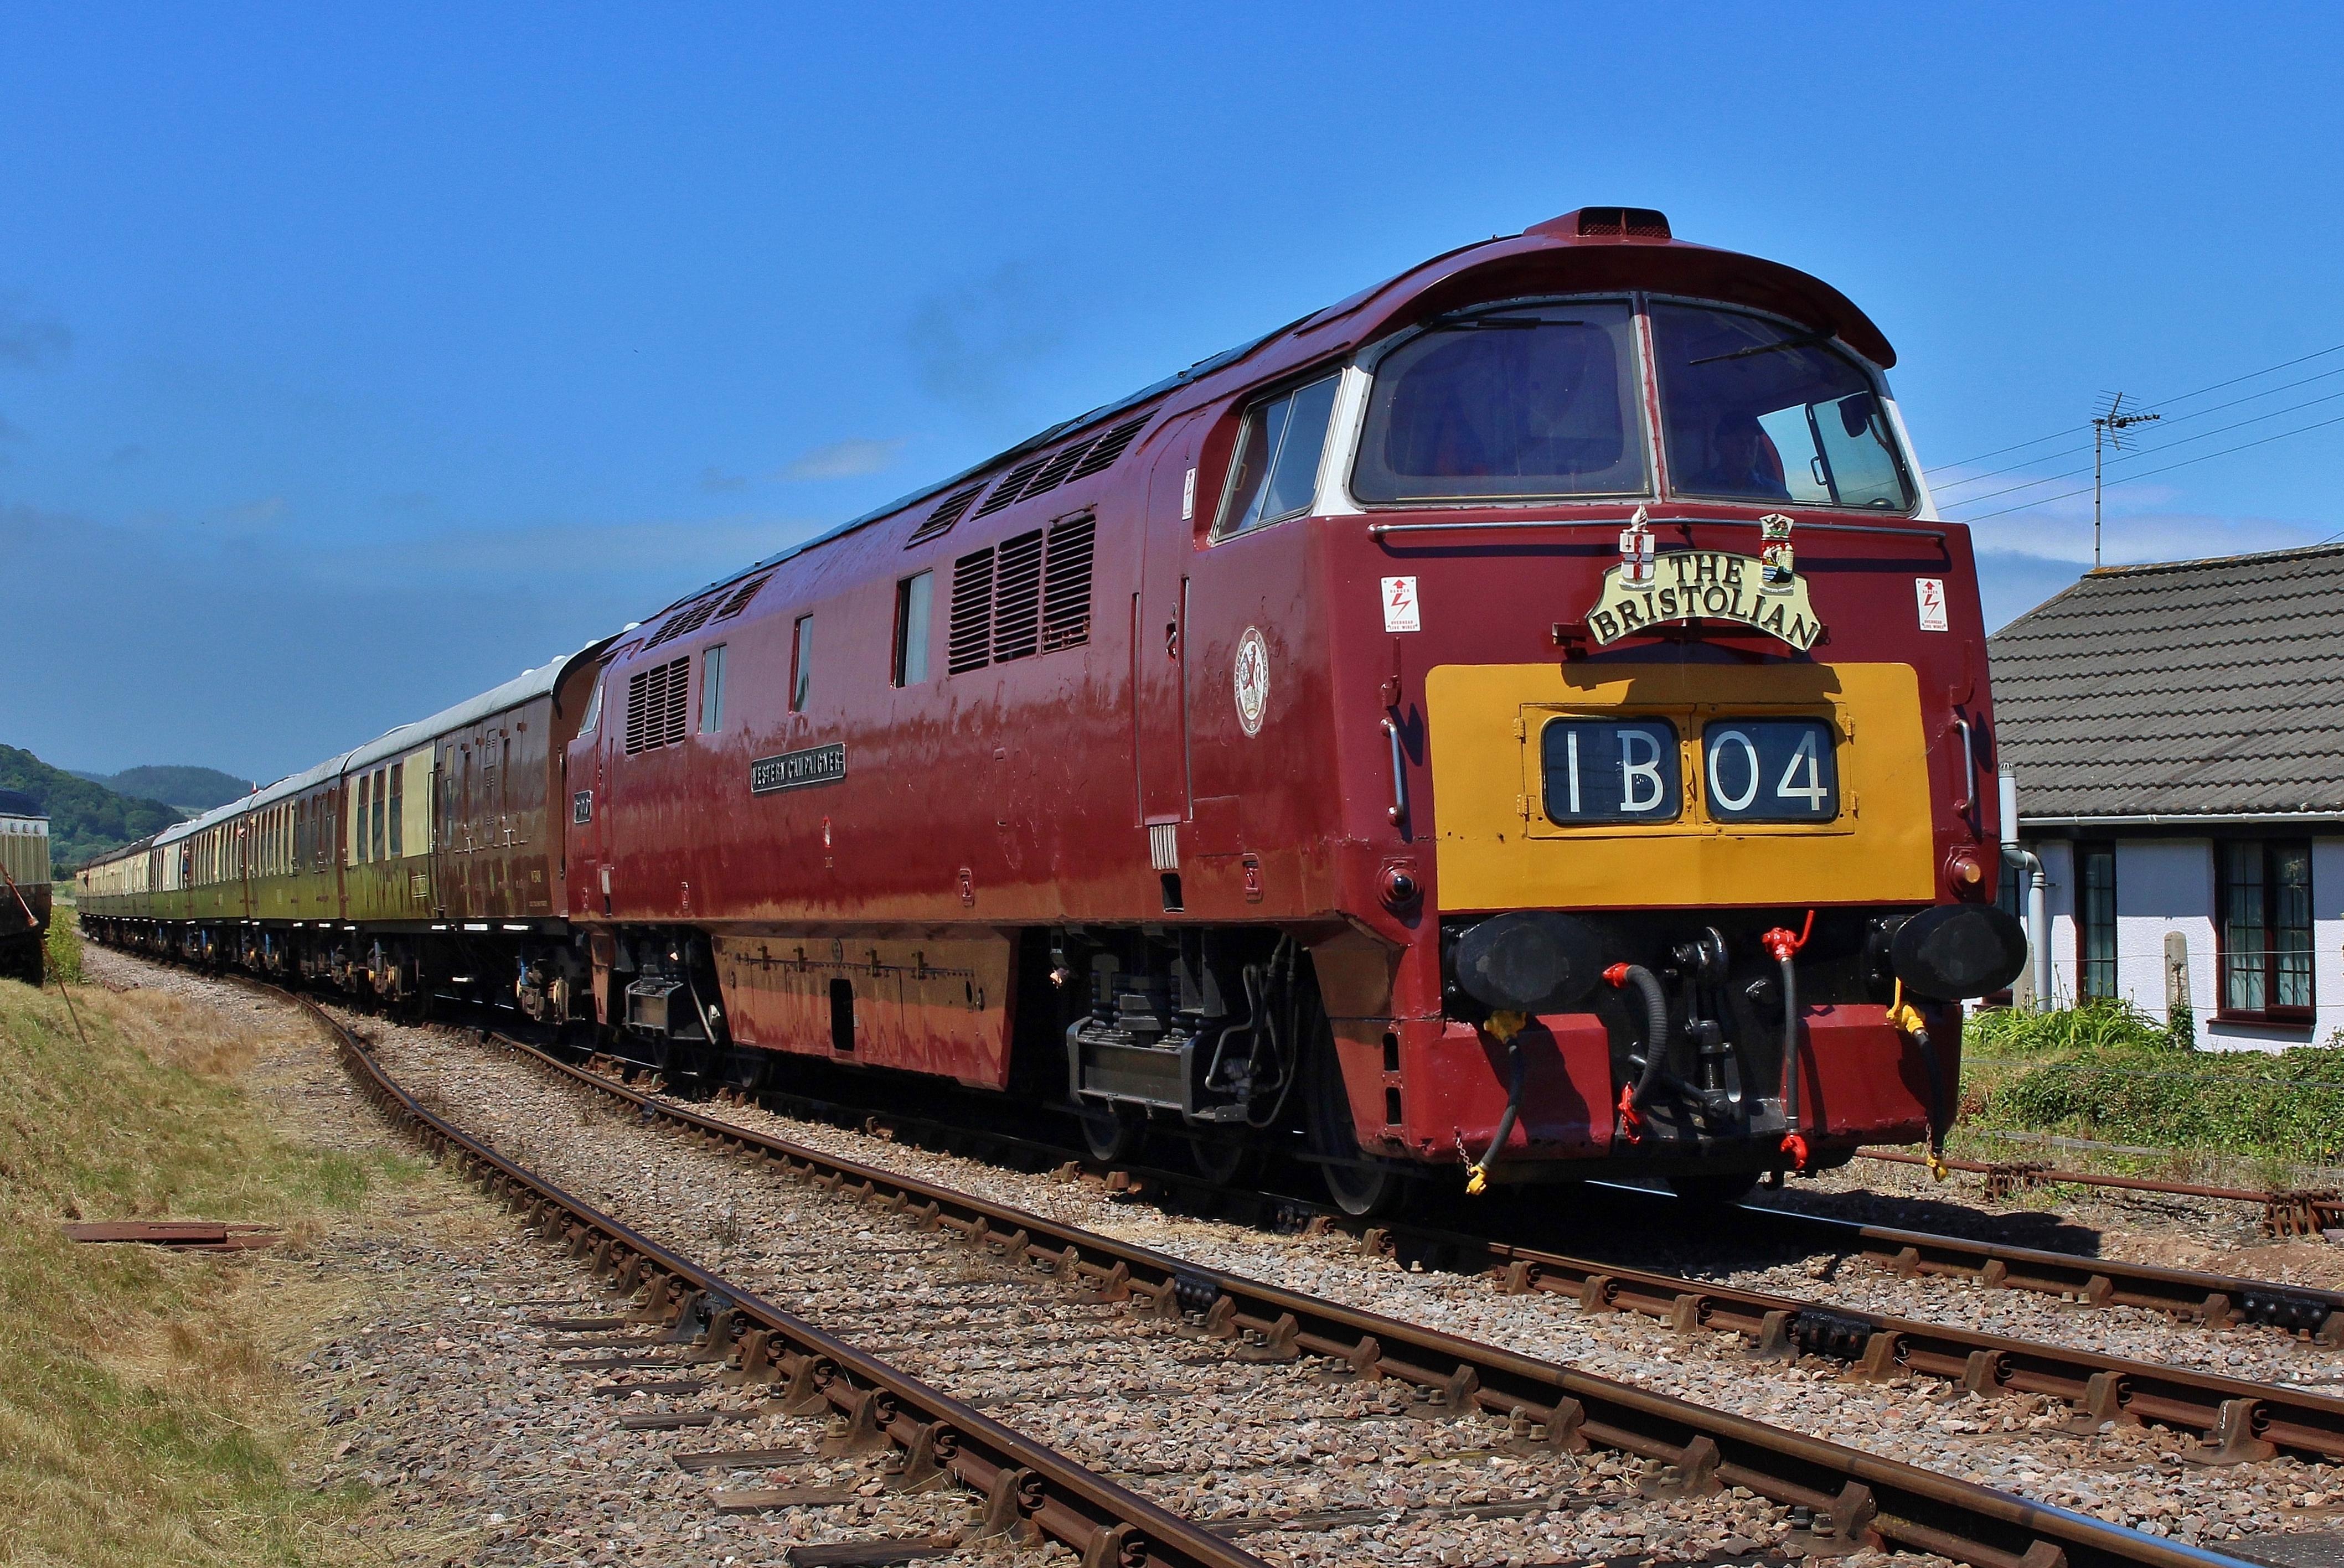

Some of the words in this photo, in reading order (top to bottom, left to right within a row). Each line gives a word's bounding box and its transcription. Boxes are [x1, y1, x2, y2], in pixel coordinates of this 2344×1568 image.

[1668, 555, 1745, 585] THE
[1592, 585, 1820, 650] BRISTOLIAN
[753, 762, 785, 784] WESTERN
[788, 751, 840, 779] CAMPAIGNER
